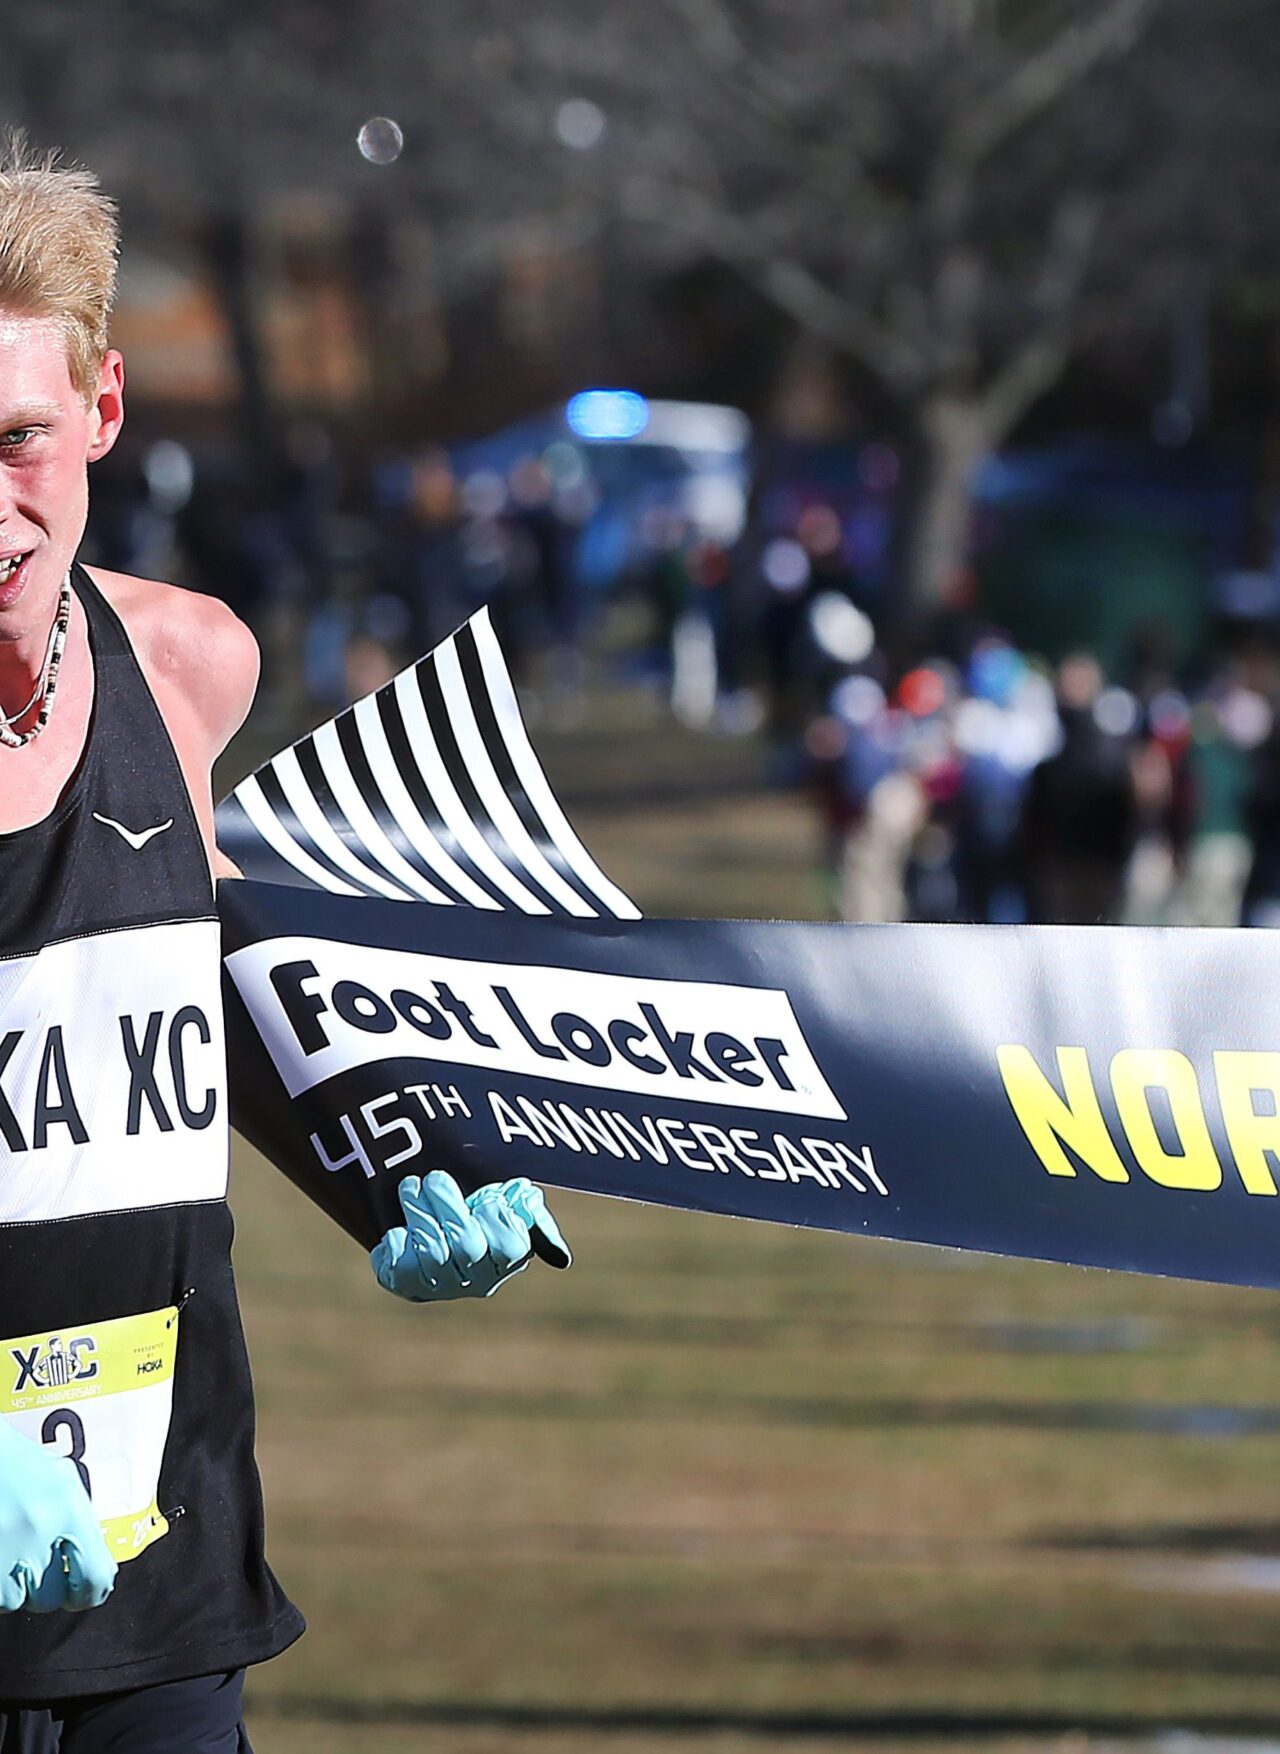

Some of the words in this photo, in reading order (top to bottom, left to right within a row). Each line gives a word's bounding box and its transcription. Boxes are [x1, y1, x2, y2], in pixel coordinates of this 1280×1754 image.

[119, 1005, 217, 1136] XC
[269, 959, 500, 1057] Foot
[490, 985, 797, 1091] Locker
[309, 1083, 473, 1179] 45TH
[487, 1090, 889, 1196] ANNIVERSARY
[995, 1043, 1280, 1197] NOR
[35, 1384, 103, 1406] ANNIVERSARY
[137, 1358, 163, 1375] HOKA
